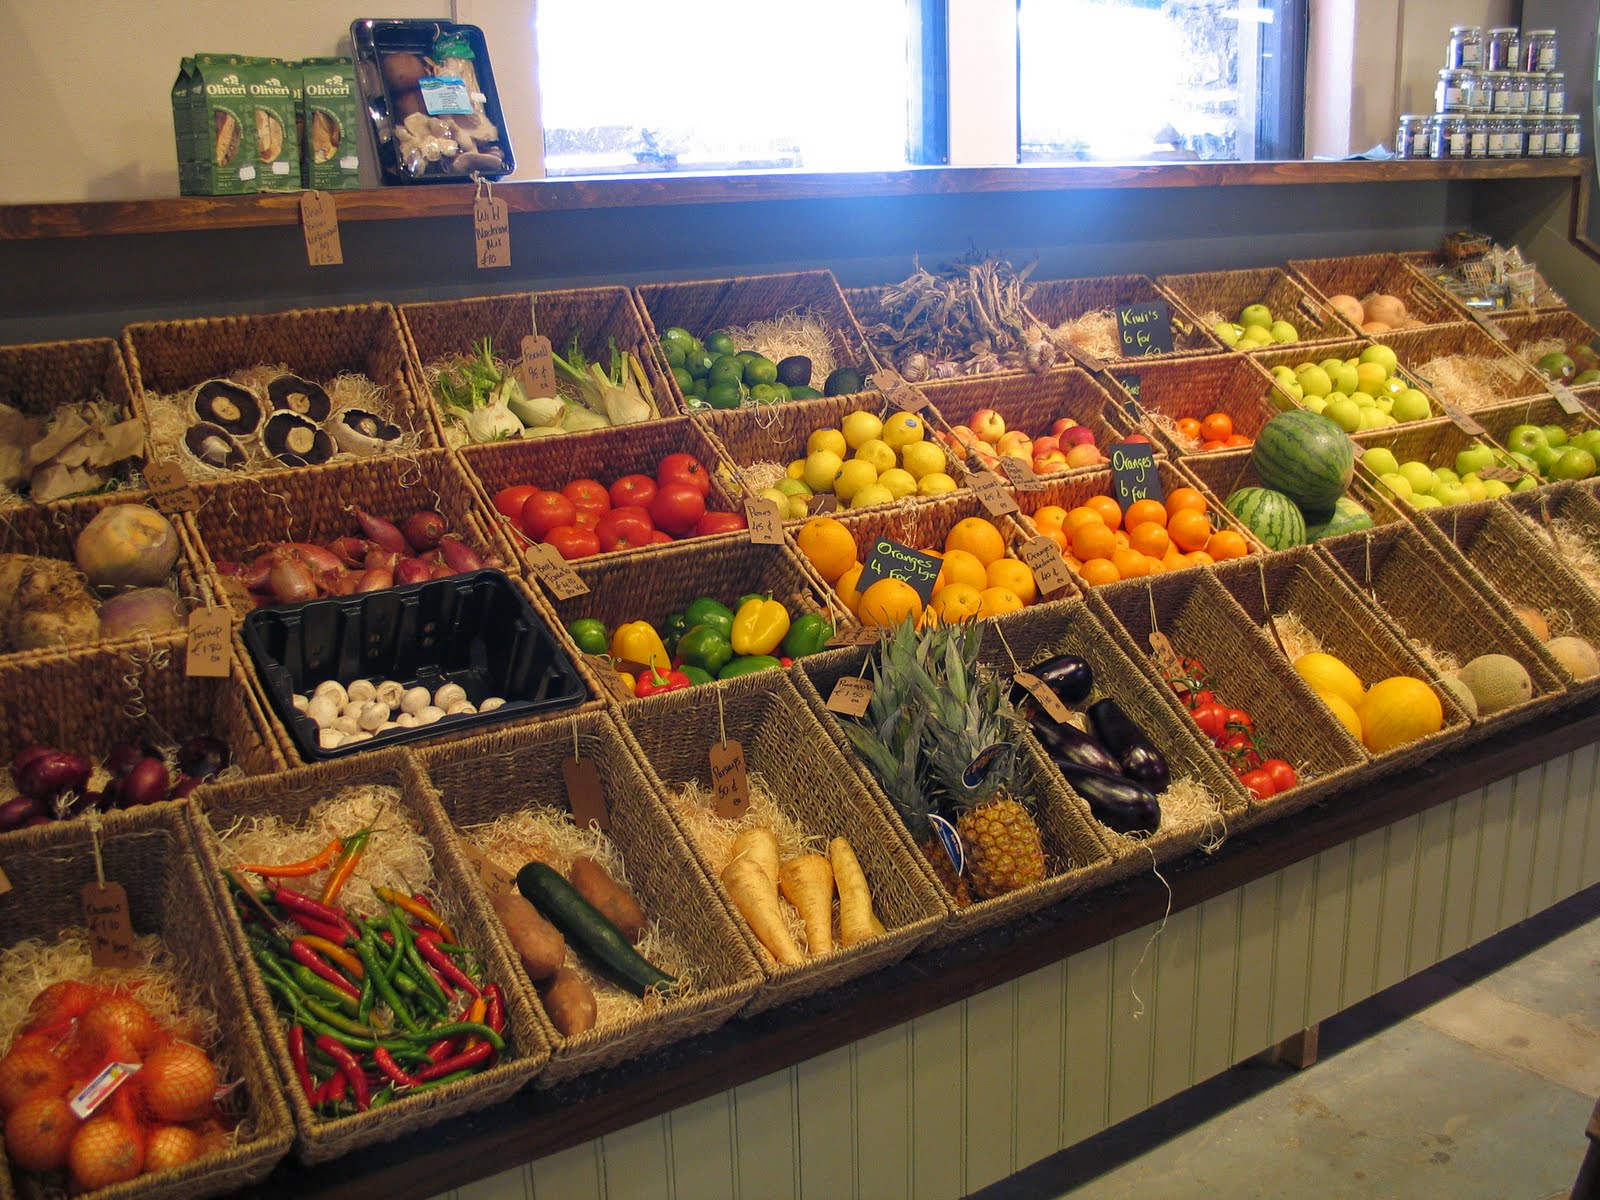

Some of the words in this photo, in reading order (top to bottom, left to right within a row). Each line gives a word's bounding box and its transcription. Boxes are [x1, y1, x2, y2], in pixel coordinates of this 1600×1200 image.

[206, 84, 247, 95] Oliveri
[250, 85, 290, 95] Oliveri
[306, 85, 350, 95] Oliveri
[1121, 308, 1158, 326] Kiwi's
[1123, 331, 1133, 344] 6
[1113, 450, 1152, 482] Oranges
[1120, 480, 1129, 497] 6
[747, 506, 771, 518] Pears
[752, 522, 764, 532] 45
[877, 542, 932, 572] Oranges
[1026, 544, 1054, 561] Oranges
[871, 559, 882, 575] 4
